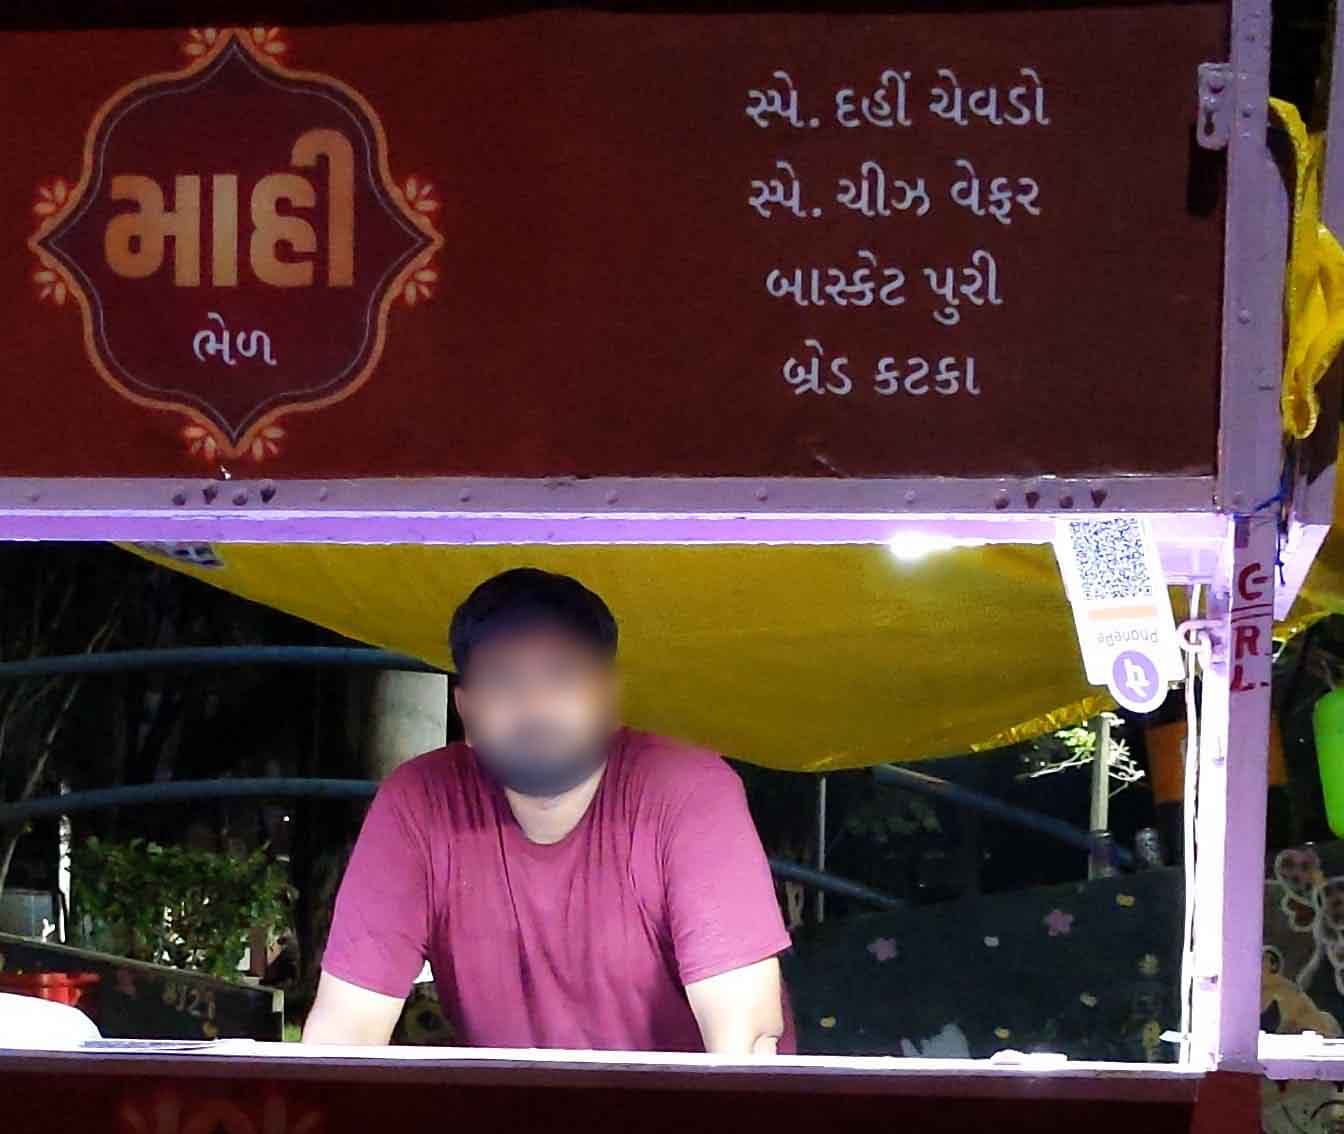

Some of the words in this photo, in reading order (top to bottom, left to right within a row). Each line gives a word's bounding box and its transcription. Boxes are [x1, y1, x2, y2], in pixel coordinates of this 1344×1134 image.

[745, 69, 820, 129] સ્પે.
[835, 69, 913, 129] દહીં
[929, 66, 1051, 127] ચેવડો
[748, 159, 823, 218] સ્પે.
[836, 159, 931, 217] ચીઝ
[949, 158, 1042, 225] વેફર
[765, 249, 906, 307] બાસ્કેટ
[922, 248, 1004, 326] પુરી
[192, 311, 278, 367] ભેળ
[782, 338, 853, 396] બ્રેડ
[873, 356, 982, 396] કટકા
